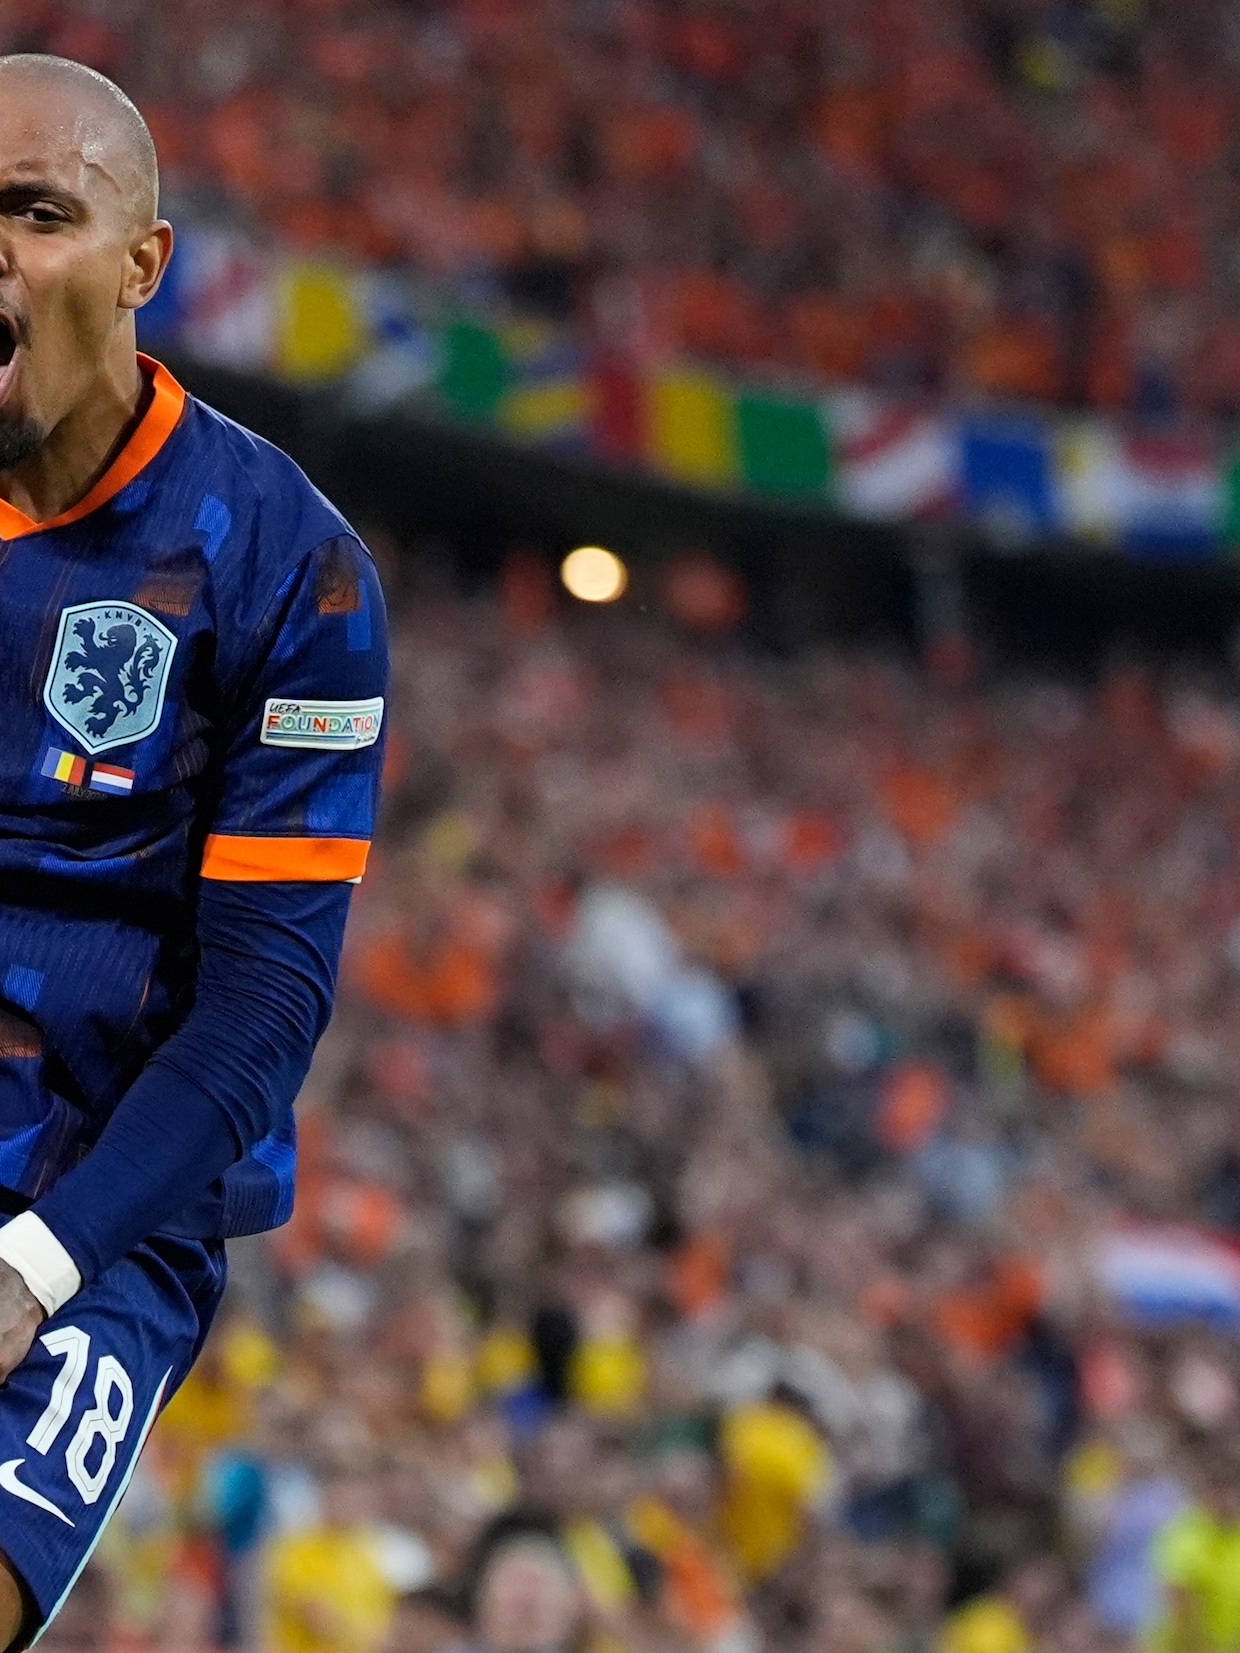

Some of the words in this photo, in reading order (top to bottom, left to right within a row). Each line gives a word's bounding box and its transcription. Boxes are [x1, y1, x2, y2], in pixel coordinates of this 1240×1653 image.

[105, 610, 142, 627] KNVB
[269, 702, 301, 714] UEFA
[266, 714, 381, 733] FOUNDATION
[26, 1325, 134, 1505] 18
